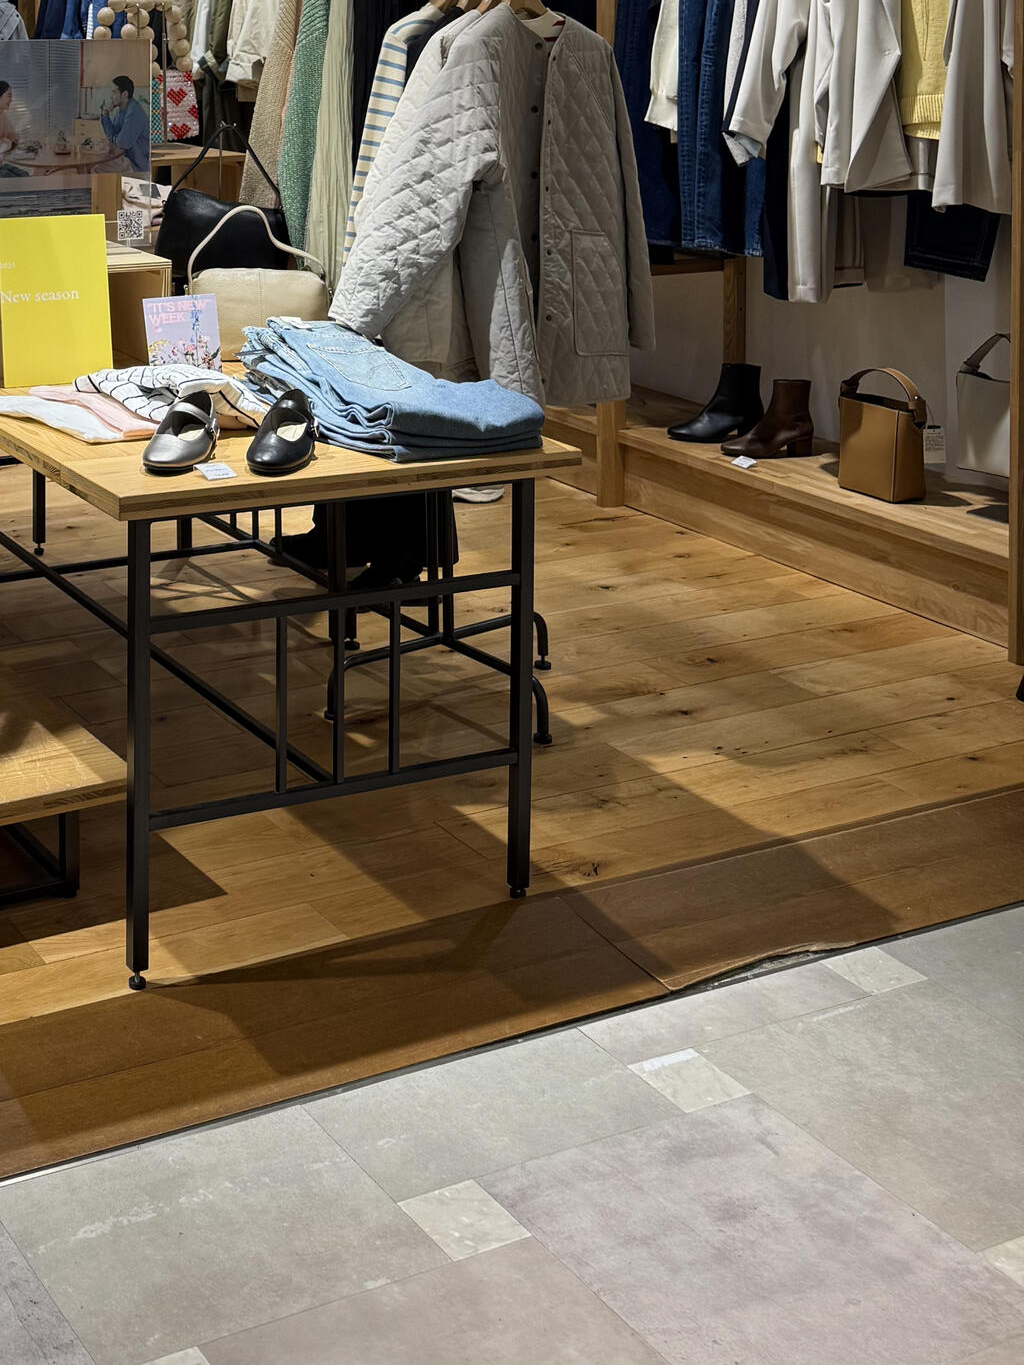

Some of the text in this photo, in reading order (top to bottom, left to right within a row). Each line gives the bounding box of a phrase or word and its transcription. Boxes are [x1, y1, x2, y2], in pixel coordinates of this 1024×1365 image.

[0, 289, 80, 304] New season
[148, 312, 186, 327] WEEK
